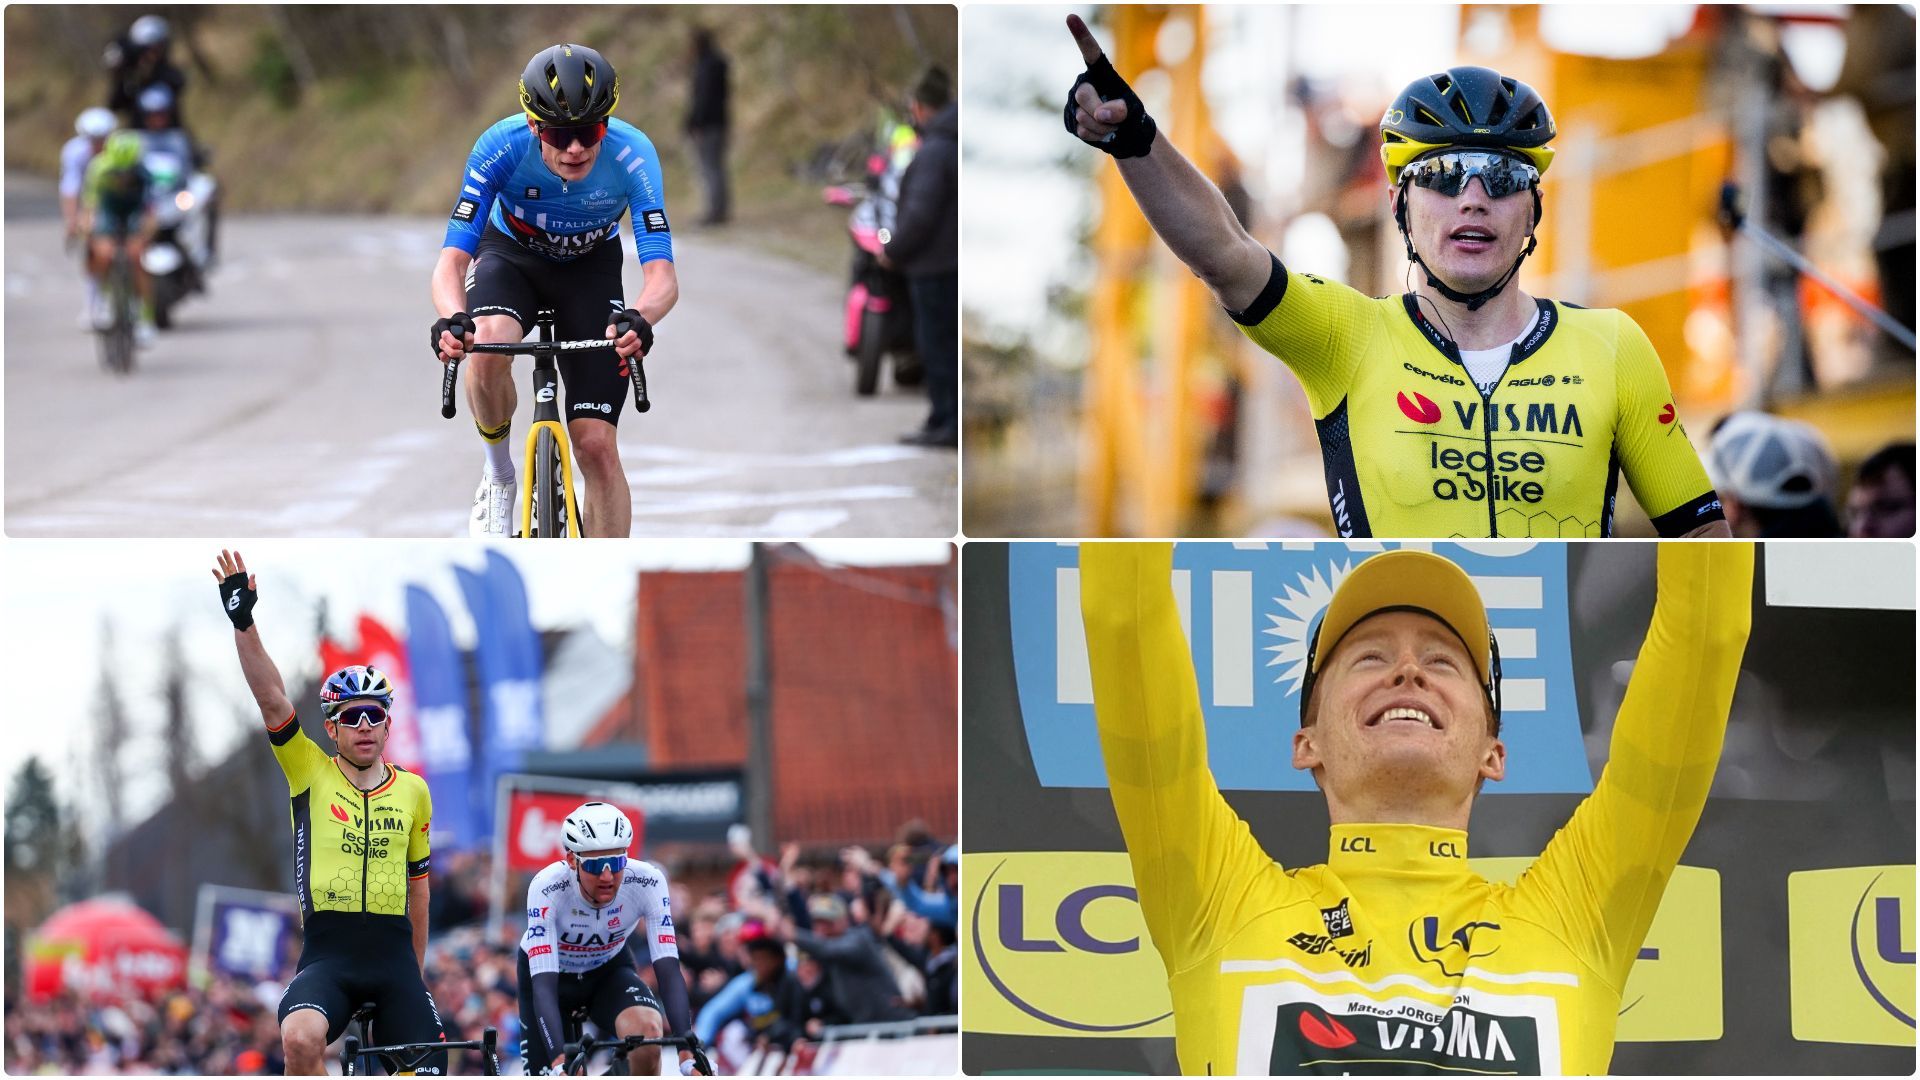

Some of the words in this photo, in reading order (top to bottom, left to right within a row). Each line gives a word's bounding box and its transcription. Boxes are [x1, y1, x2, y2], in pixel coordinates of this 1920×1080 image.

[480, 142, 512, 173] ITALIA.IT
[1403, 362, 1466, 387] cervélo
[1452, 400, 1584, 438] VISMA
[1431, 441, 1545, 473] lease
[354, 814, 404, 832] VISMA
[342, 828, 390, 847] lease
[1340, 837, 1376, 853] LCL
[1429, 841, 1461, 859] LCL
[541, 878, 571, 897] presight
[998, 884, 1140, 955] LC
[561, 929, 626, 947] UAE
[1347, 1002, 1393, 1016] Matteo
[1397, 994, 1470, 1024] JORGEON
[1377, 1010, 1516, 1061] VISMA
